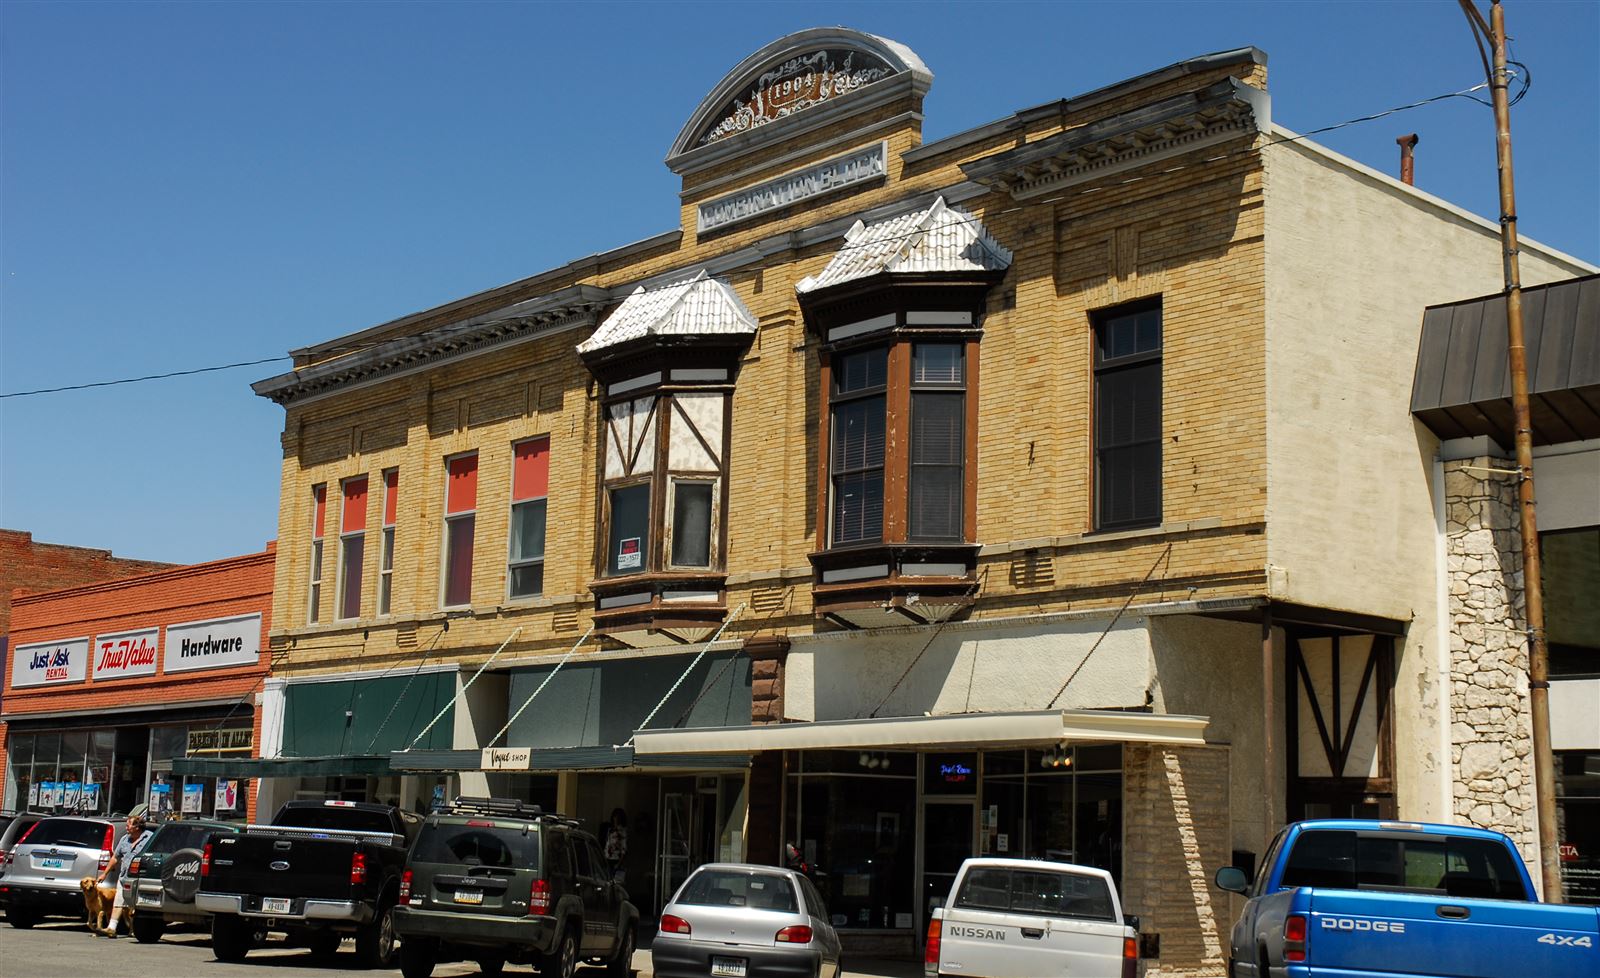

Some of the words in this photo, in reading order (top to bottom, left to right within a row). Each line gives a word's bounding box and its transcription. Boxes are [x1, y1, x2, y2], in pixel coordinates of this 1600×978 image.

[774, 72, 812, 99] 1904
[702, 175, 816, 228] COMBINATION
[820, 153, 882, 191] BLOCK
[181, 634, 243, 658] Hardware
[30, 650, 51, 670] Just
[52, 647, 70, 667] Ask
[45, 667, 68, 678] RENTAL
[491, 748, 510, 769] Vogue
[512, 754, 528, 762] SHOP
[1559, 845, 1579, 856] CTA
[461, 876, 477, 885] Jeep
[950, 926, 1006, 941] NISSAN
[1321, 917, 1405, 933] DODGE
